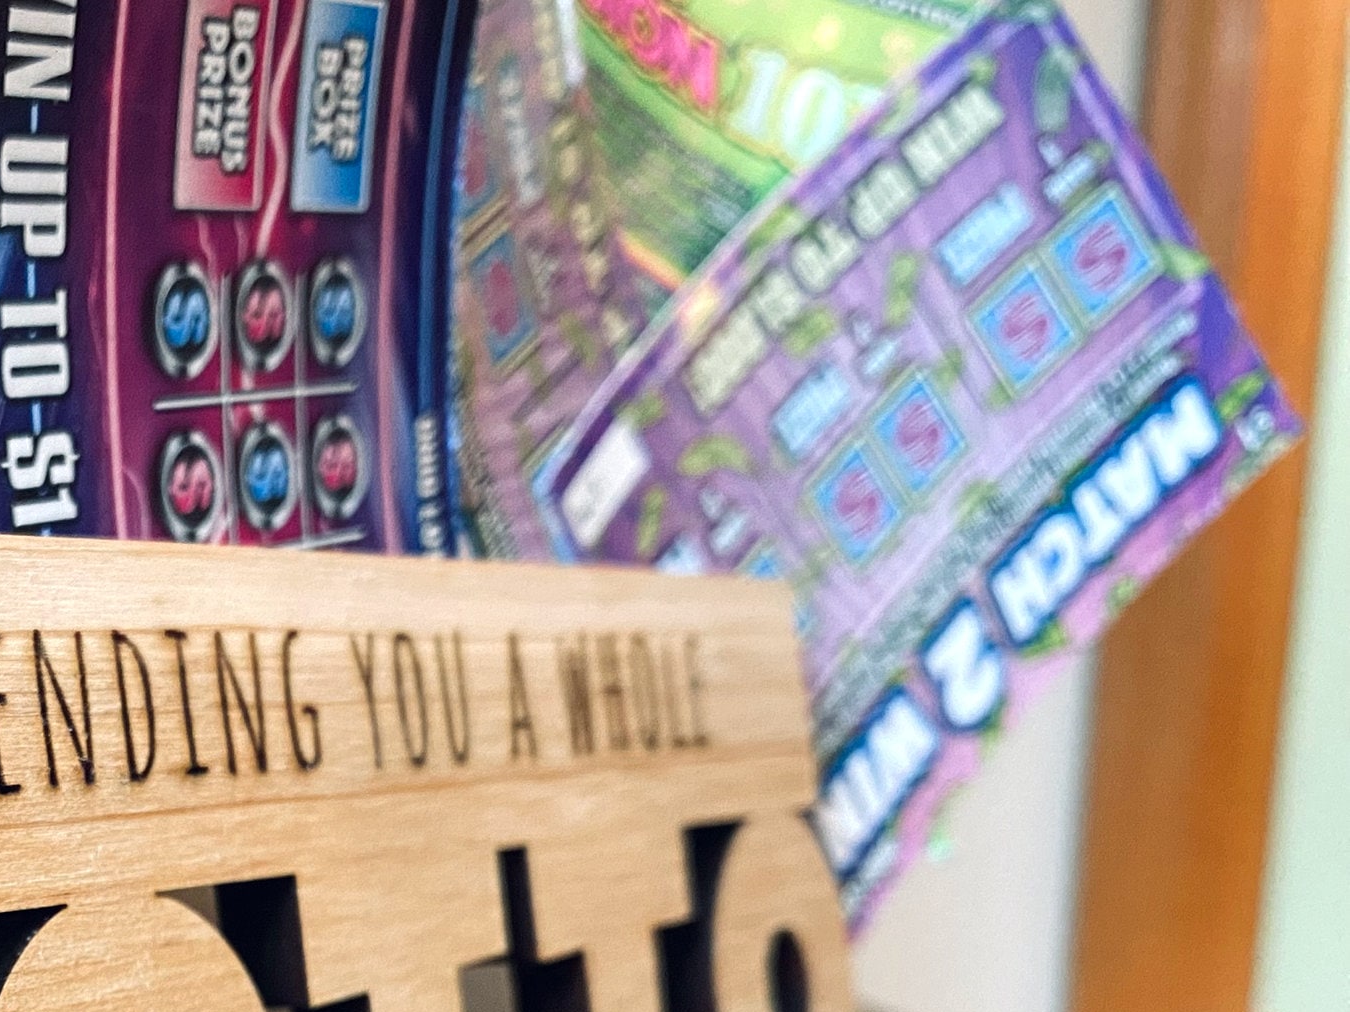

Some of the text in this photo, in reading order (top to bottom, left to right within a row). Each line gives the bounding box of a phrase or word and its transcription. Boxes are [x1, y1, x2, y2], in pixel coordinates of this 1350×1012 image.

[4, 0, 77, 101] IN
[194, 17, 230, 157] PRIZE
[221, 7, 259, 173] BONUS
[311, 43, 341, 150] BOX
[333, 37, 367, 162] PRIZE
[991, 383, 1221, 642] MATCH
[349, 628, 470, 771] YOU
[507, 633, 540, 763] A
[557, 630, 711, 758] WHOLE
[922, 606, 1006, 730] 2
